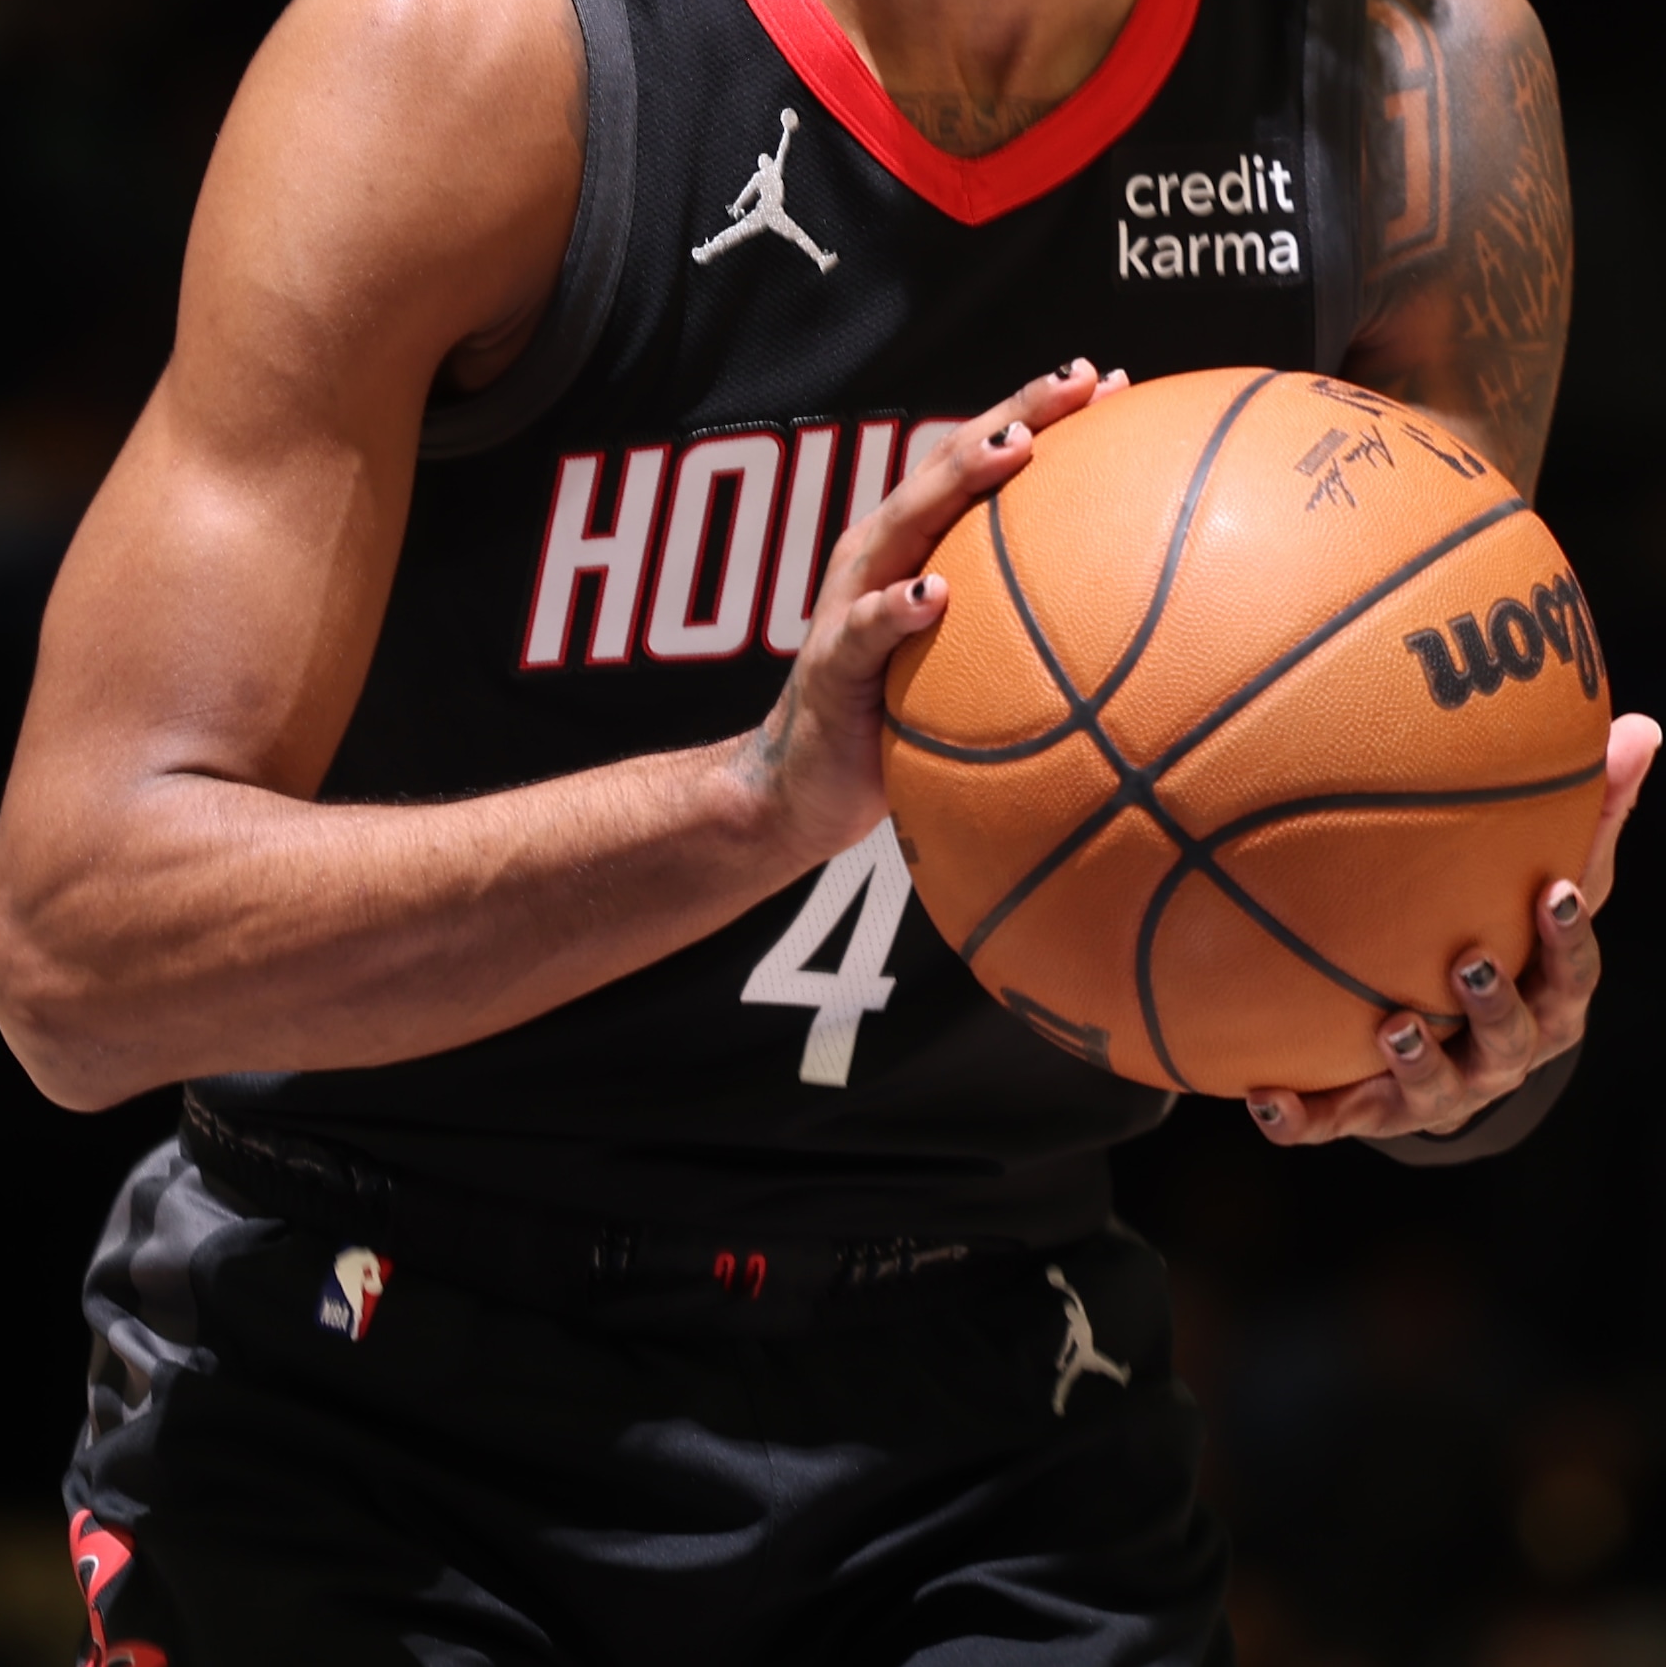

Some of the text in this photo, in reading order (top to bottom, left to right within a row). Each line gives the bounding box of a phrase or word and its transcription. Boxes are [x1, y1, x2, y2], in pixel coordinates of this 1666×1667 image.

[1118, 219, 1300, 280] karma
[1125, 153, 1295, 218] credit
[519, 416, 975, 671] HOU
[739, 816, 913, 1089] 4
